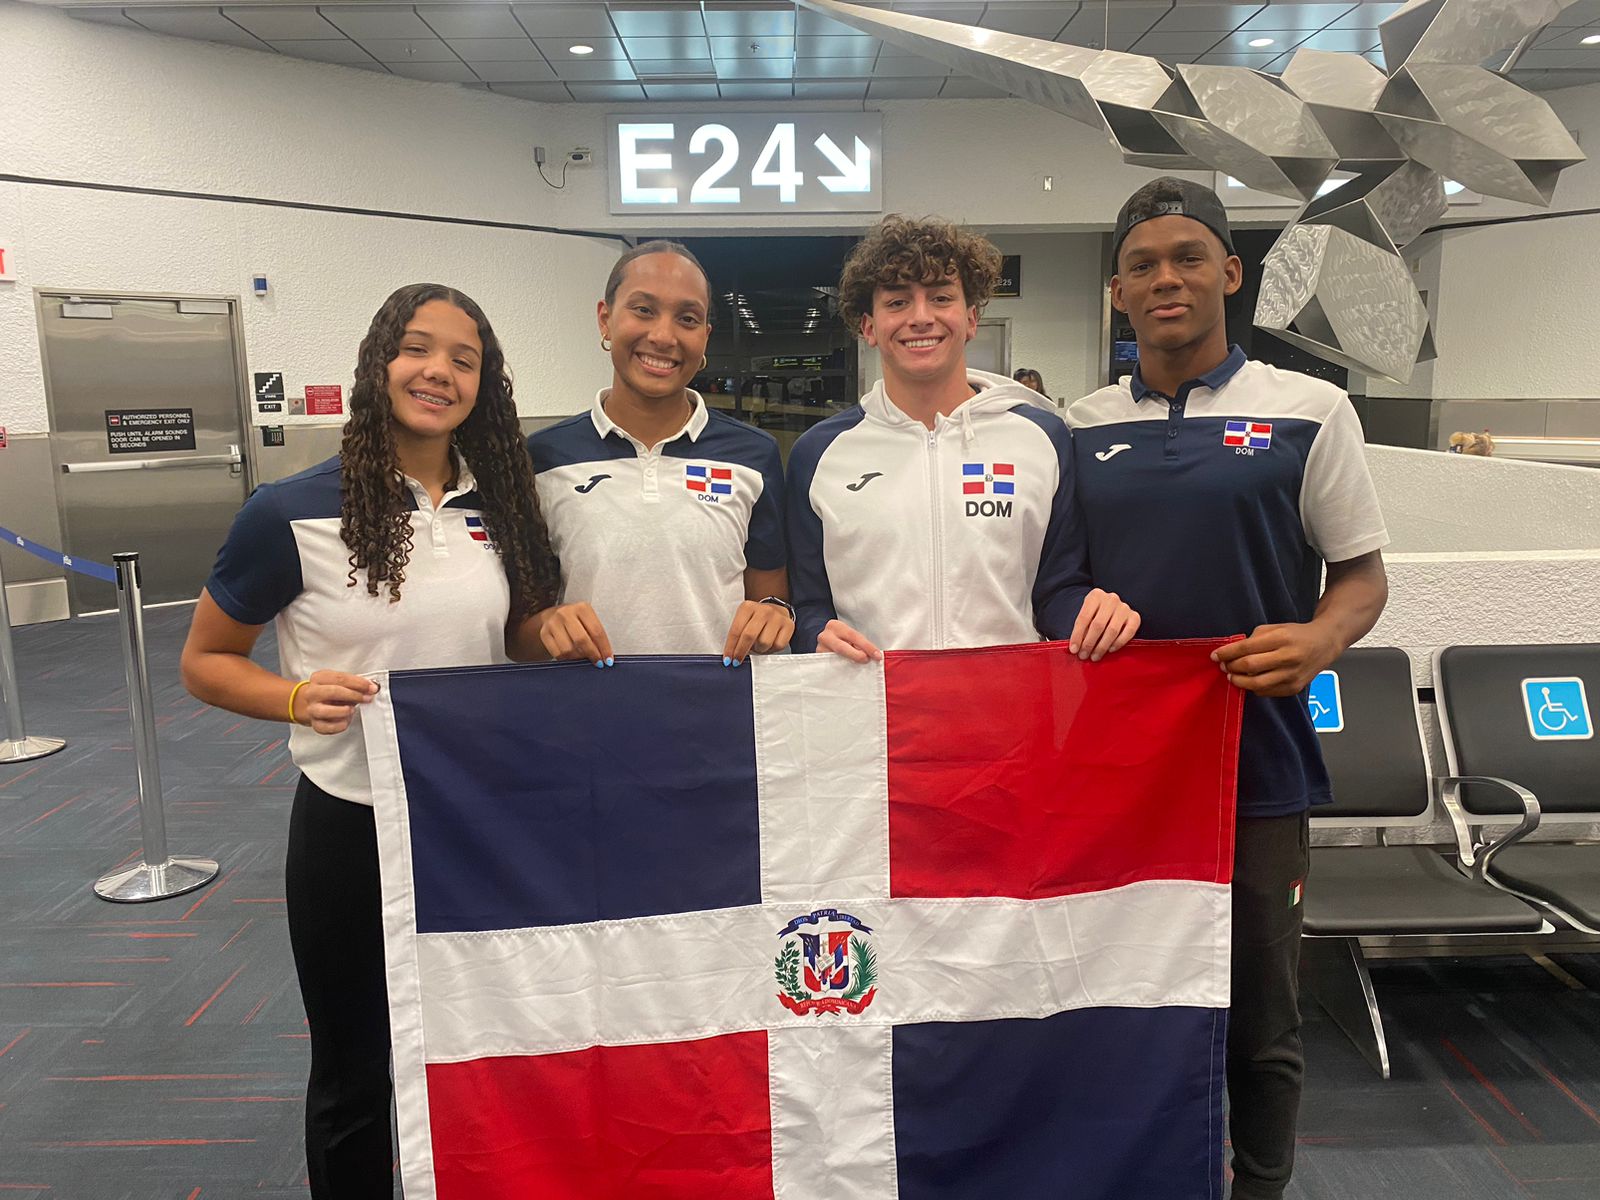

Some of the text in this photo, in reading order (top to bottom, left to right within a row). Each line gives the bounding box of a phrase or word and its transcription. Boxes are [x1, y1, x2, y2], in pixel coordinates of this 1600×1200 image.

[618, 123, 804, 204] E24
[1235, 447, 1254, 456] DOM
[697, 493, 719, 503] DOM
[965, 500, 1013, 518] DOM
[812, 910, 836, 919] PATRIA
[836, 915, 860, 927] LIBERTAD
